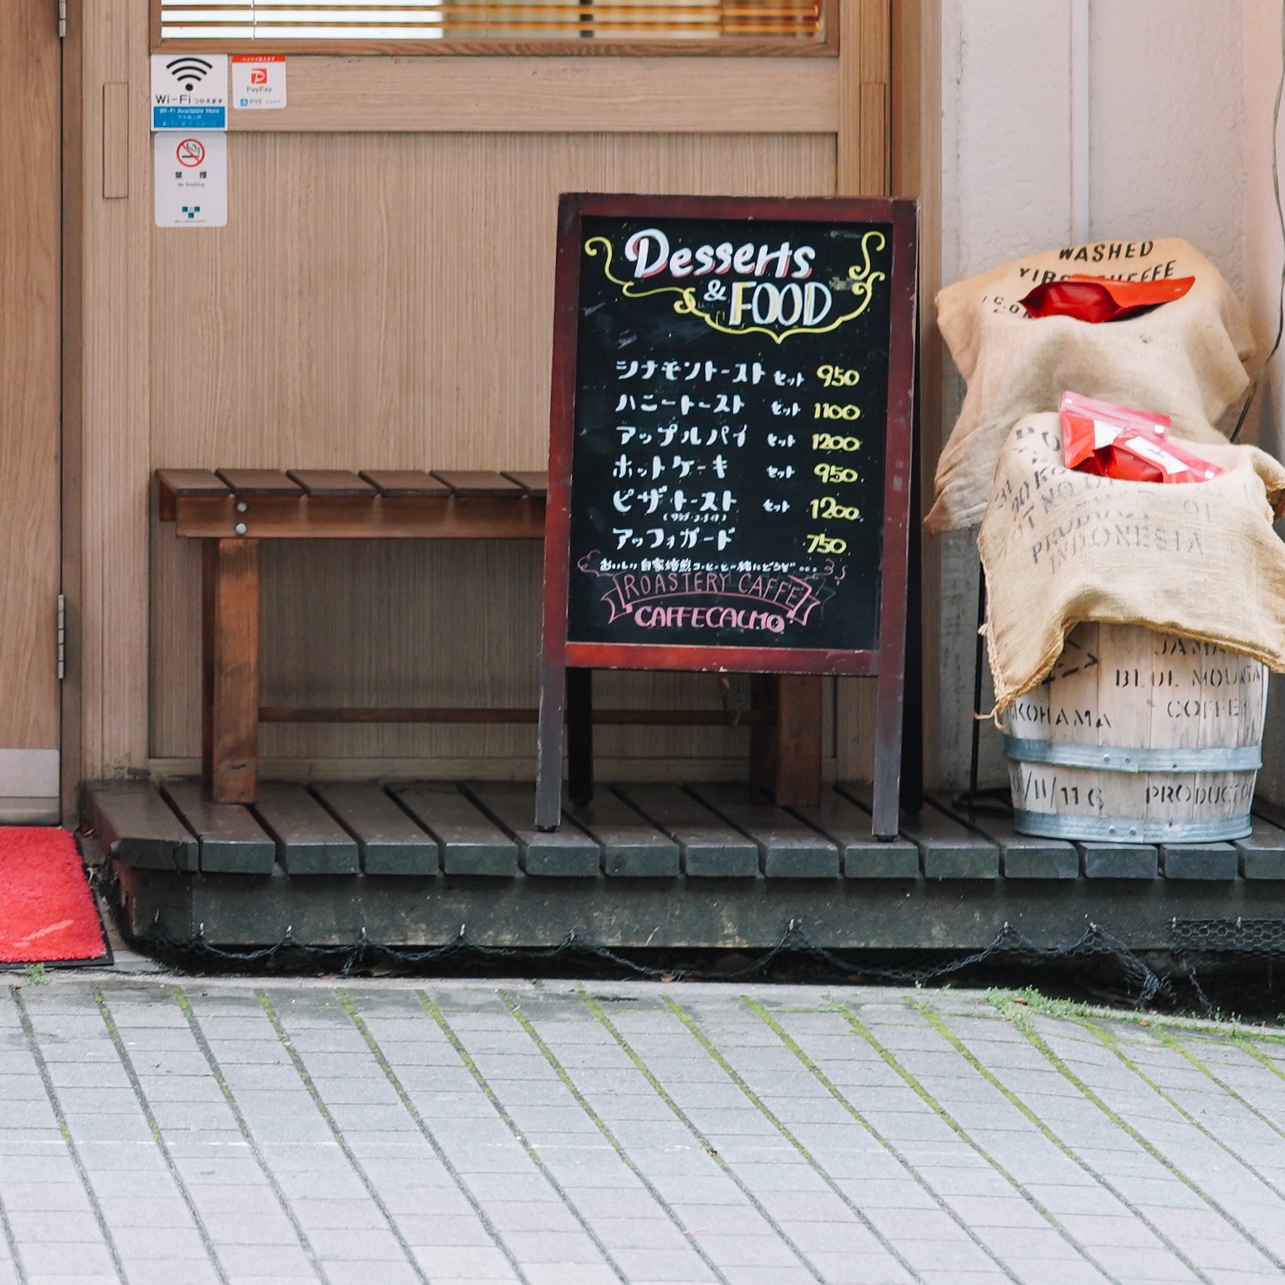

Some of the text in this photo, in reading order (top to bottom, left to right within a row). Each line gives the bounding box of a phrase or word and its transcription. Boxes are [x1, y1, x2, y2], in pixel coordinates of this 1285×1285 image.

[155, 94, 192, 105] Wi-Fi
[246, 85, 273, 94] PayPay
[625, 228, 816, 278] Desserts
[1059, 240, 1154, 262] WASHED
[703, 279, 832, 326] & FOOD
[616, 360, 860, 387] シナモントースト セット 950
[615, 394, 860, 420] ハニートースト セット 1100
[616, 424, 860, 451] アップルパイ セット 1200
[612, 454, 858, 483] ホットケーキ セット 950
[612, 485, 860, 520] ピザトースト セット 1200
[807, 534, 847, 554] 750
[624, 572, 729, 600] ROASTERY
[1192, 665, 1261, 688] MOUNTA
